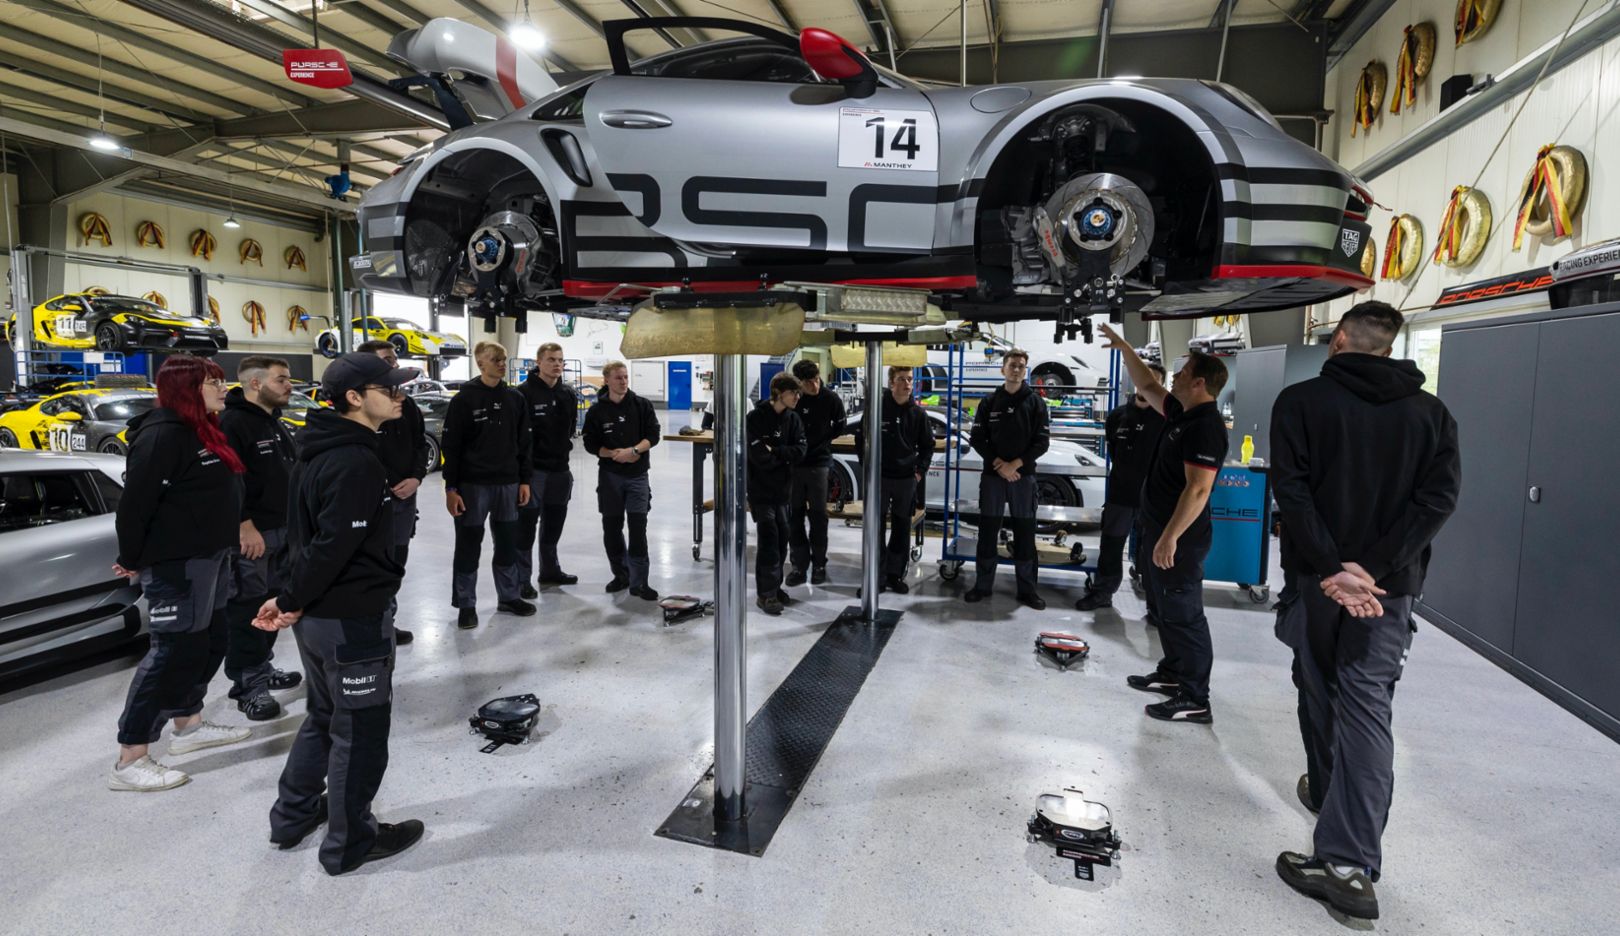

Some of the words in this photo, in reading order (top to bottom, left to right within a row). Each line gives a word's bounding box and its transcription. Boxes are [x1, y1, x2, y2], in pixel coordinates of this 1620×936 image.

[865, 116, 921, 160] 14
[1344, 231, 1358, 241] TAG
[342, 676, 367, 685] Mobil
